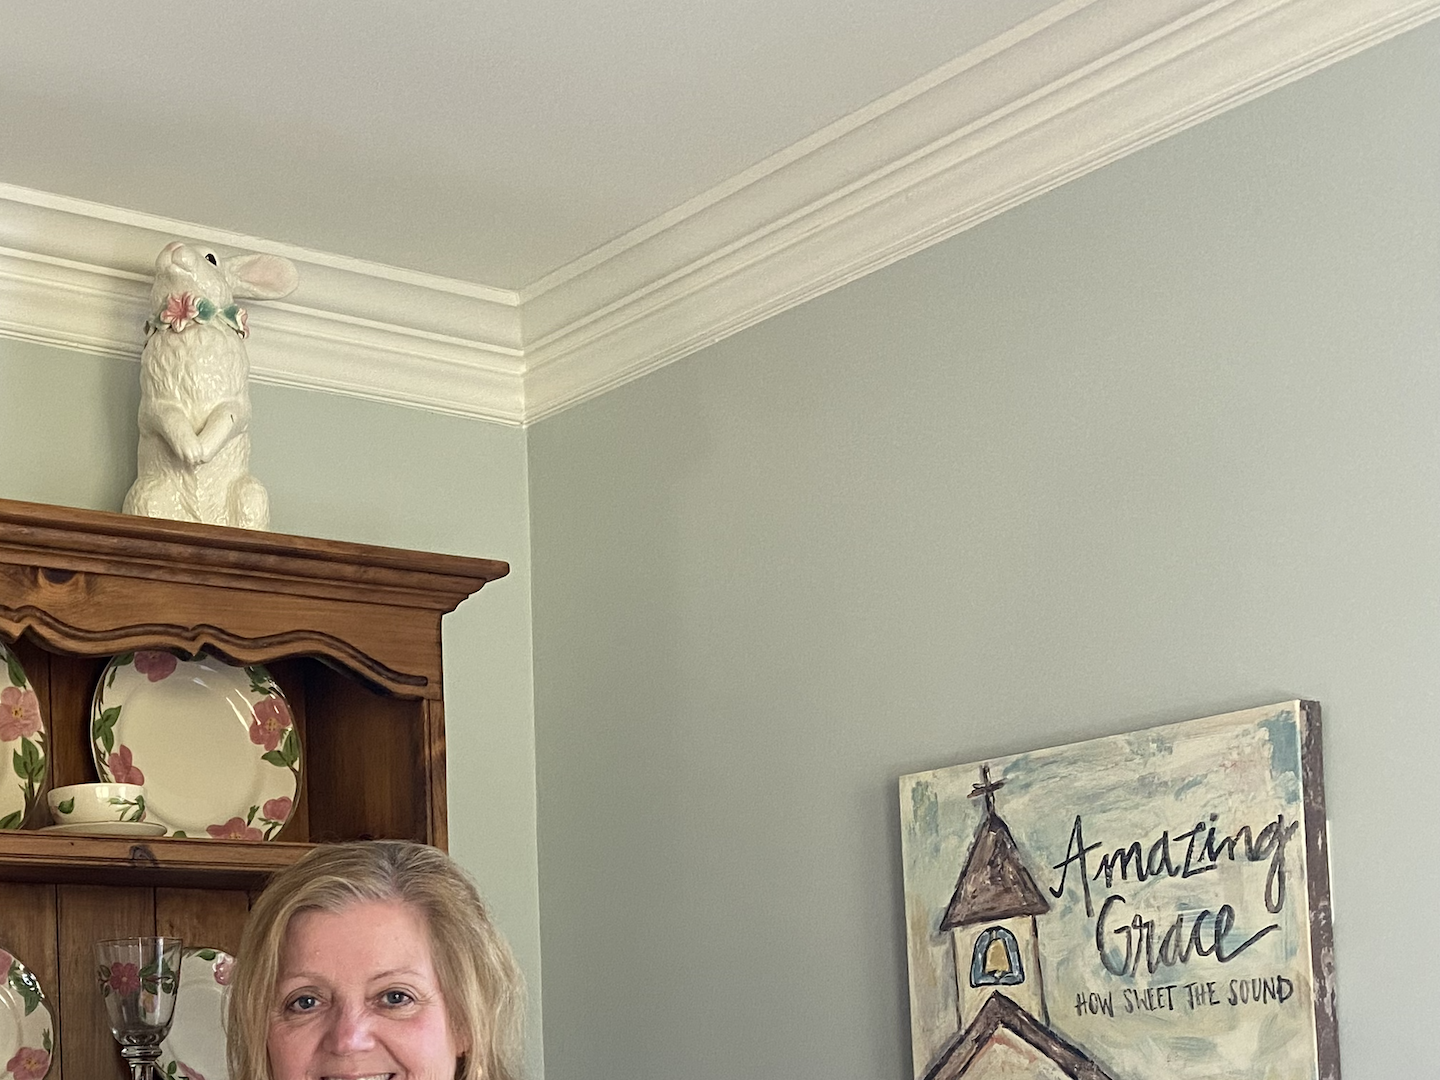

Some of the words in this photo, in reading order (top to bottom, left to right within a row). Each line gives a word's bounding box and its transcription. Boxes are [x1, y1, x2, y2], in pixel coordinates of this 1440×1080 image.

[1048, 814, 1299, 917] Amazing
[1096, 894, 1281, 977] Grace
[1074, 990, 1115, 1018] HOW
[1123, 984, 1177, 1014] SWEET
[1184, 981, 1221, 1010] THE
[1228, 974, 1294, 1006] SOUND
